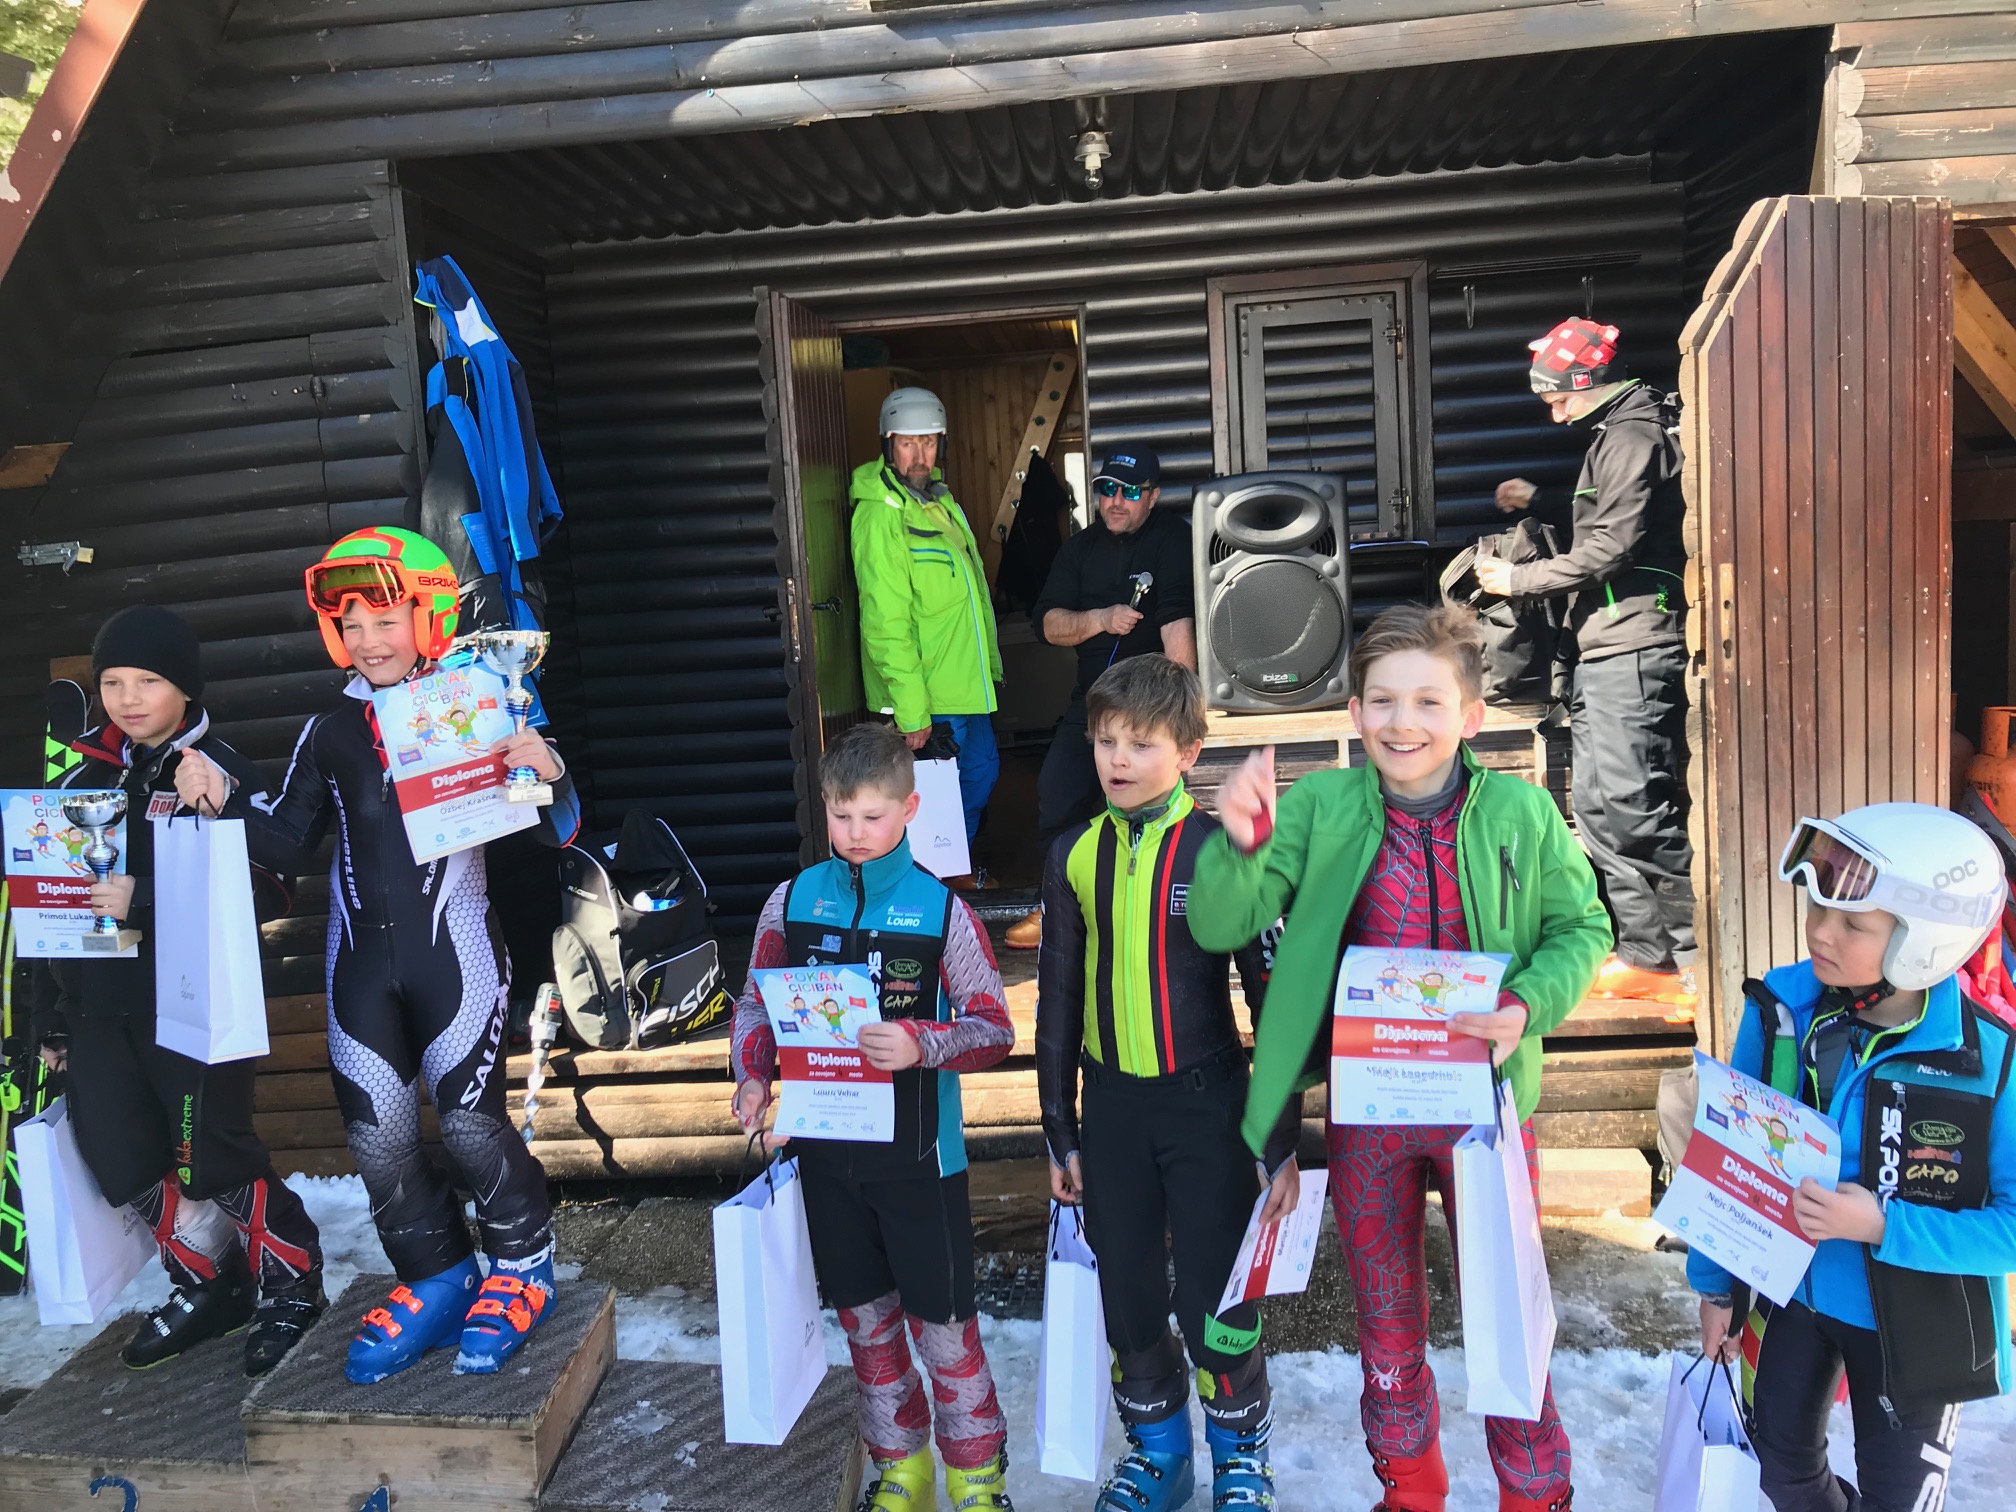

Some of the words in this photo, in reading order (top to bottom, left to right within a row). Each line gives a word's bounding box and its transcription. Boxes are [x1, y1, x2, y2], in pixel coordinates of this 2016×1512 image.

[408, 669, 470, 695] POKAL
[431, 763, 495, 789] Diploma
[34, 808, 64, 818] CICI
[422, 858, 438, 896] SALOM
[39, 912, 68, 920] Primož
[886, 916, 921, 927] LOURO
[783, 970, 836, 983] POKAL
[788, 982, 844, 993] CICIBAN
[1373, 1023, 1449, 1044] Diploma
[807, 1051, 861, 1068] Diploma
[1729, 1070, 1792, 1110] POKAL
[1732, 1081, 1800, 1124] CICIBAN
[1721, 1154, 1789, 1208] Diploma
[1706, 1189, 1726, 1212] Nejc
[1726, 1203, 1774, 1240] Poljanšek
